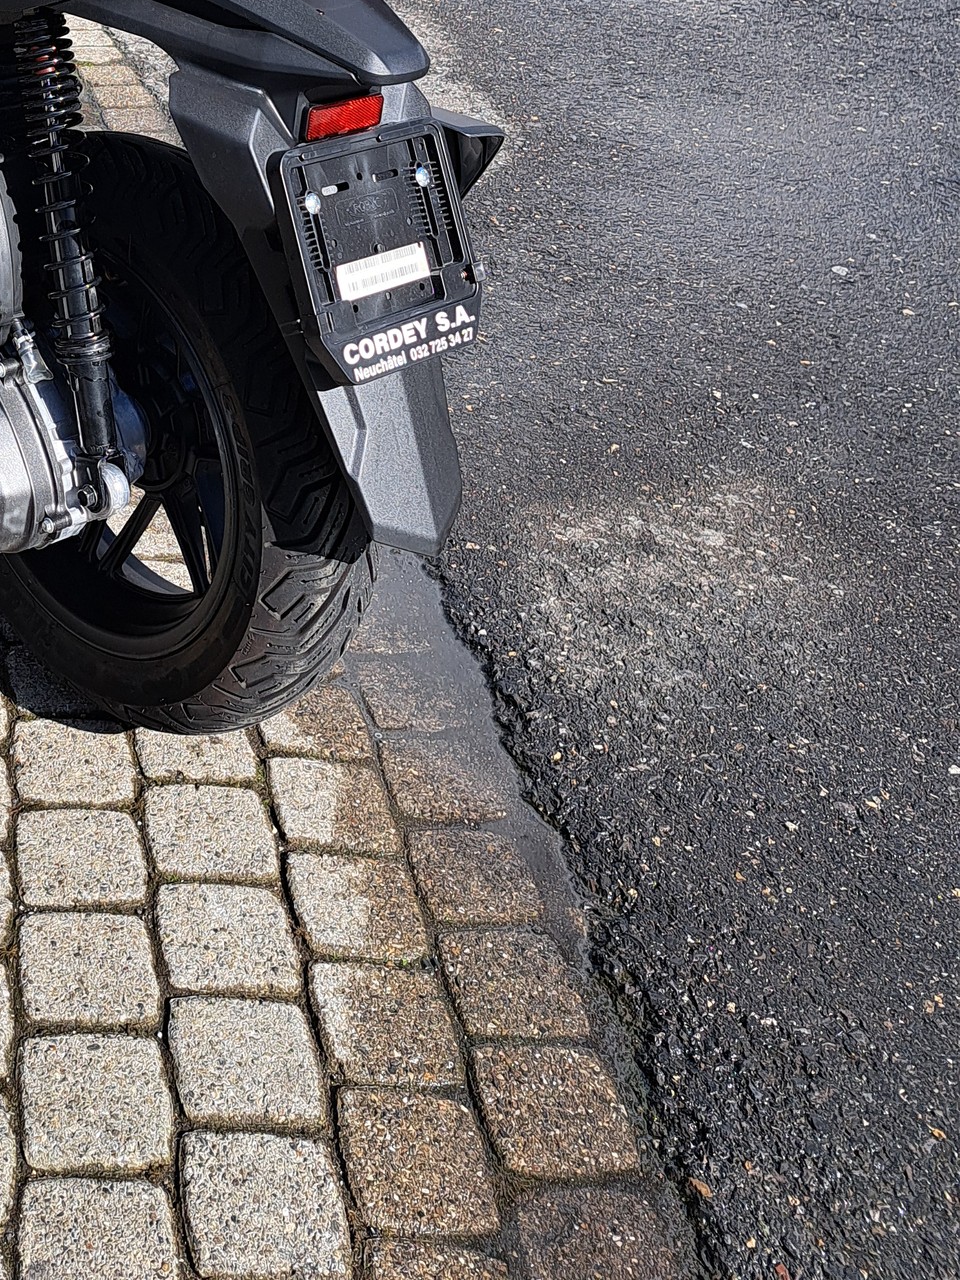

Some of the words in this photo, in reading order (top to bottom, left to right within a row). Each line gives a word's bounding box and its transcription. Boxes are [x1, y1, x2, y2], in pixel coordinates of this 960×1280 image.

[342, 317, 428, 365] CORDEY
[435, 304, 476, 332] S.A.
[353, 349, 407, 382] Neuchâtel
[410, 346, 430, 361] 032
[430, 337, 448, 354] 725
[448, 331, 462, 347] 34
[462, 327, 474, 342] 27
